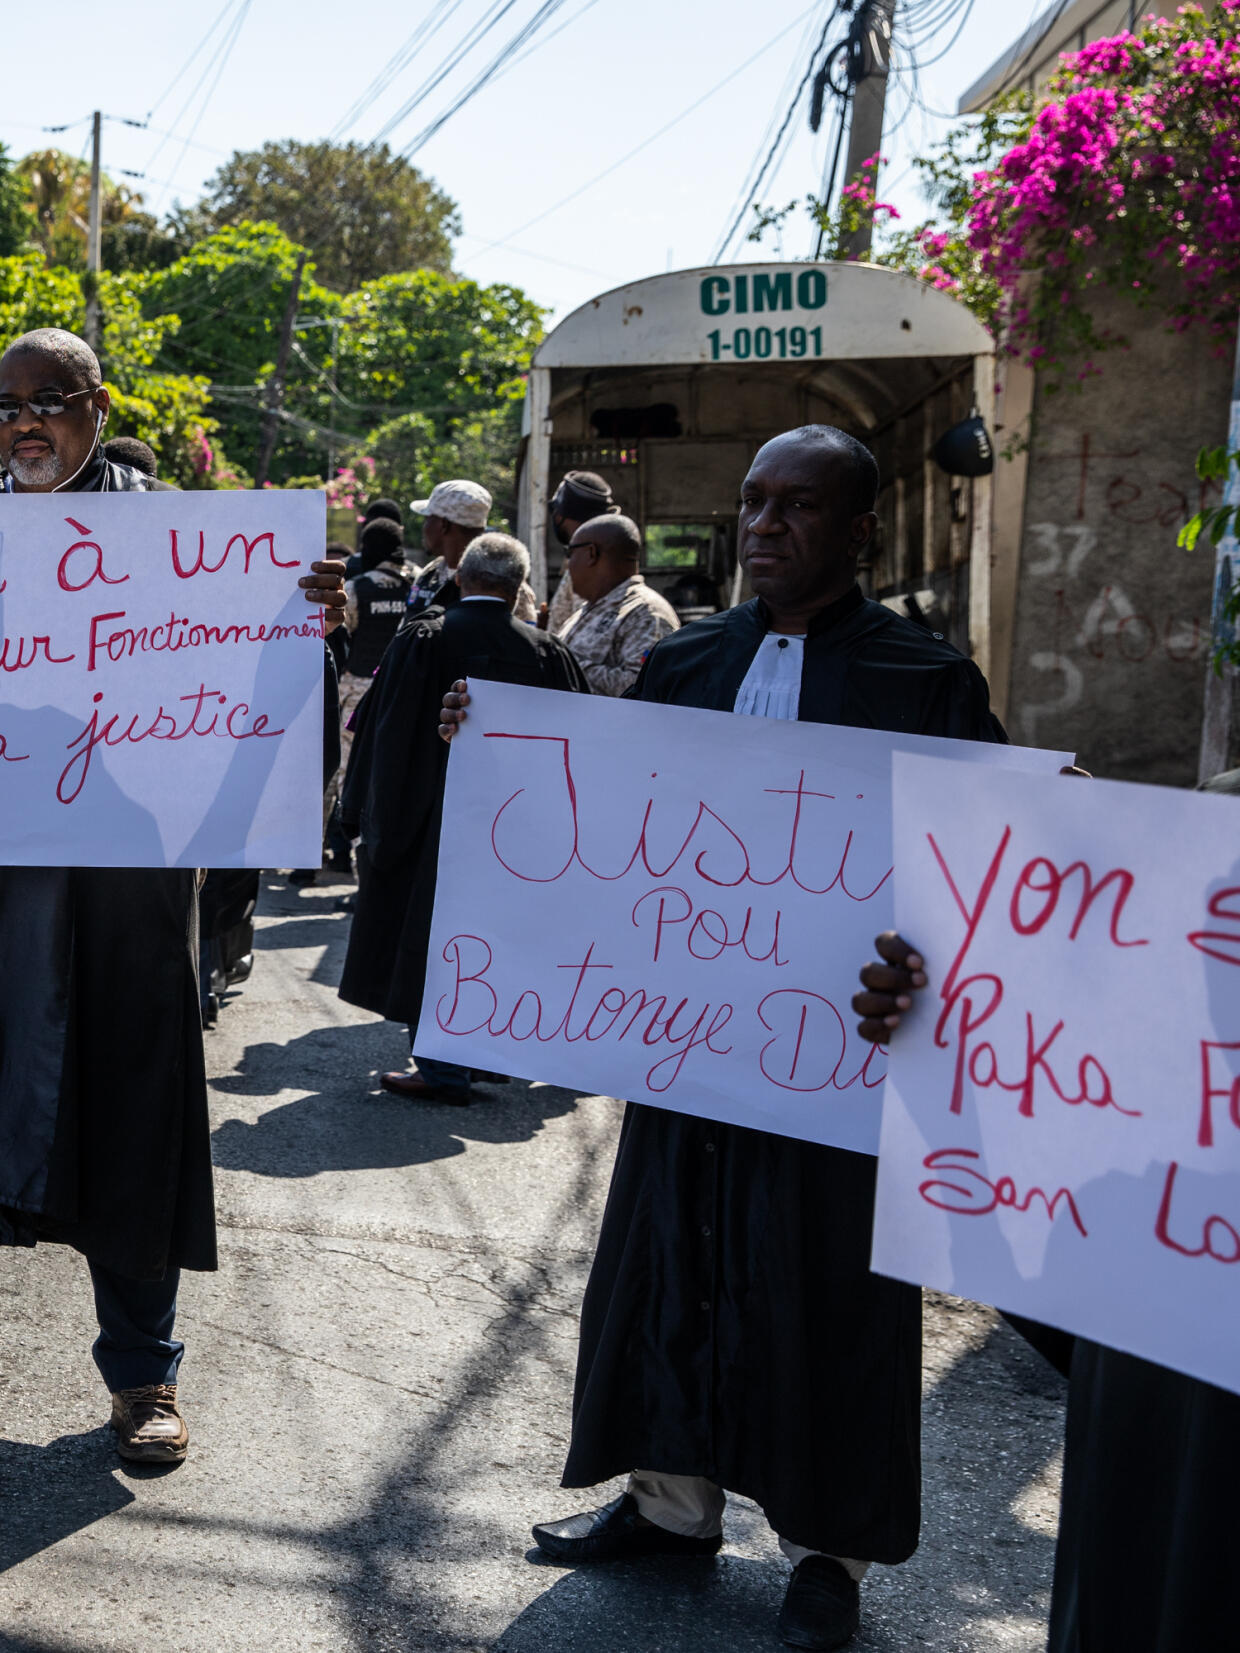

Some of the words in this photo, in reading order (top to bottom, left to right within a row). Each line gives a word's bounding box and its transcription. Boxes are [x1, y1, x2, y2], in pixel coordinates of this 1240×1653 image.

[700, 269, 827, 316] CIMO
[706, 325, 822, 361] 1-00191
[57, 516, 130, 592] à
[170, 529, 302, 579] un
[56, 683, 285, 804] justice
